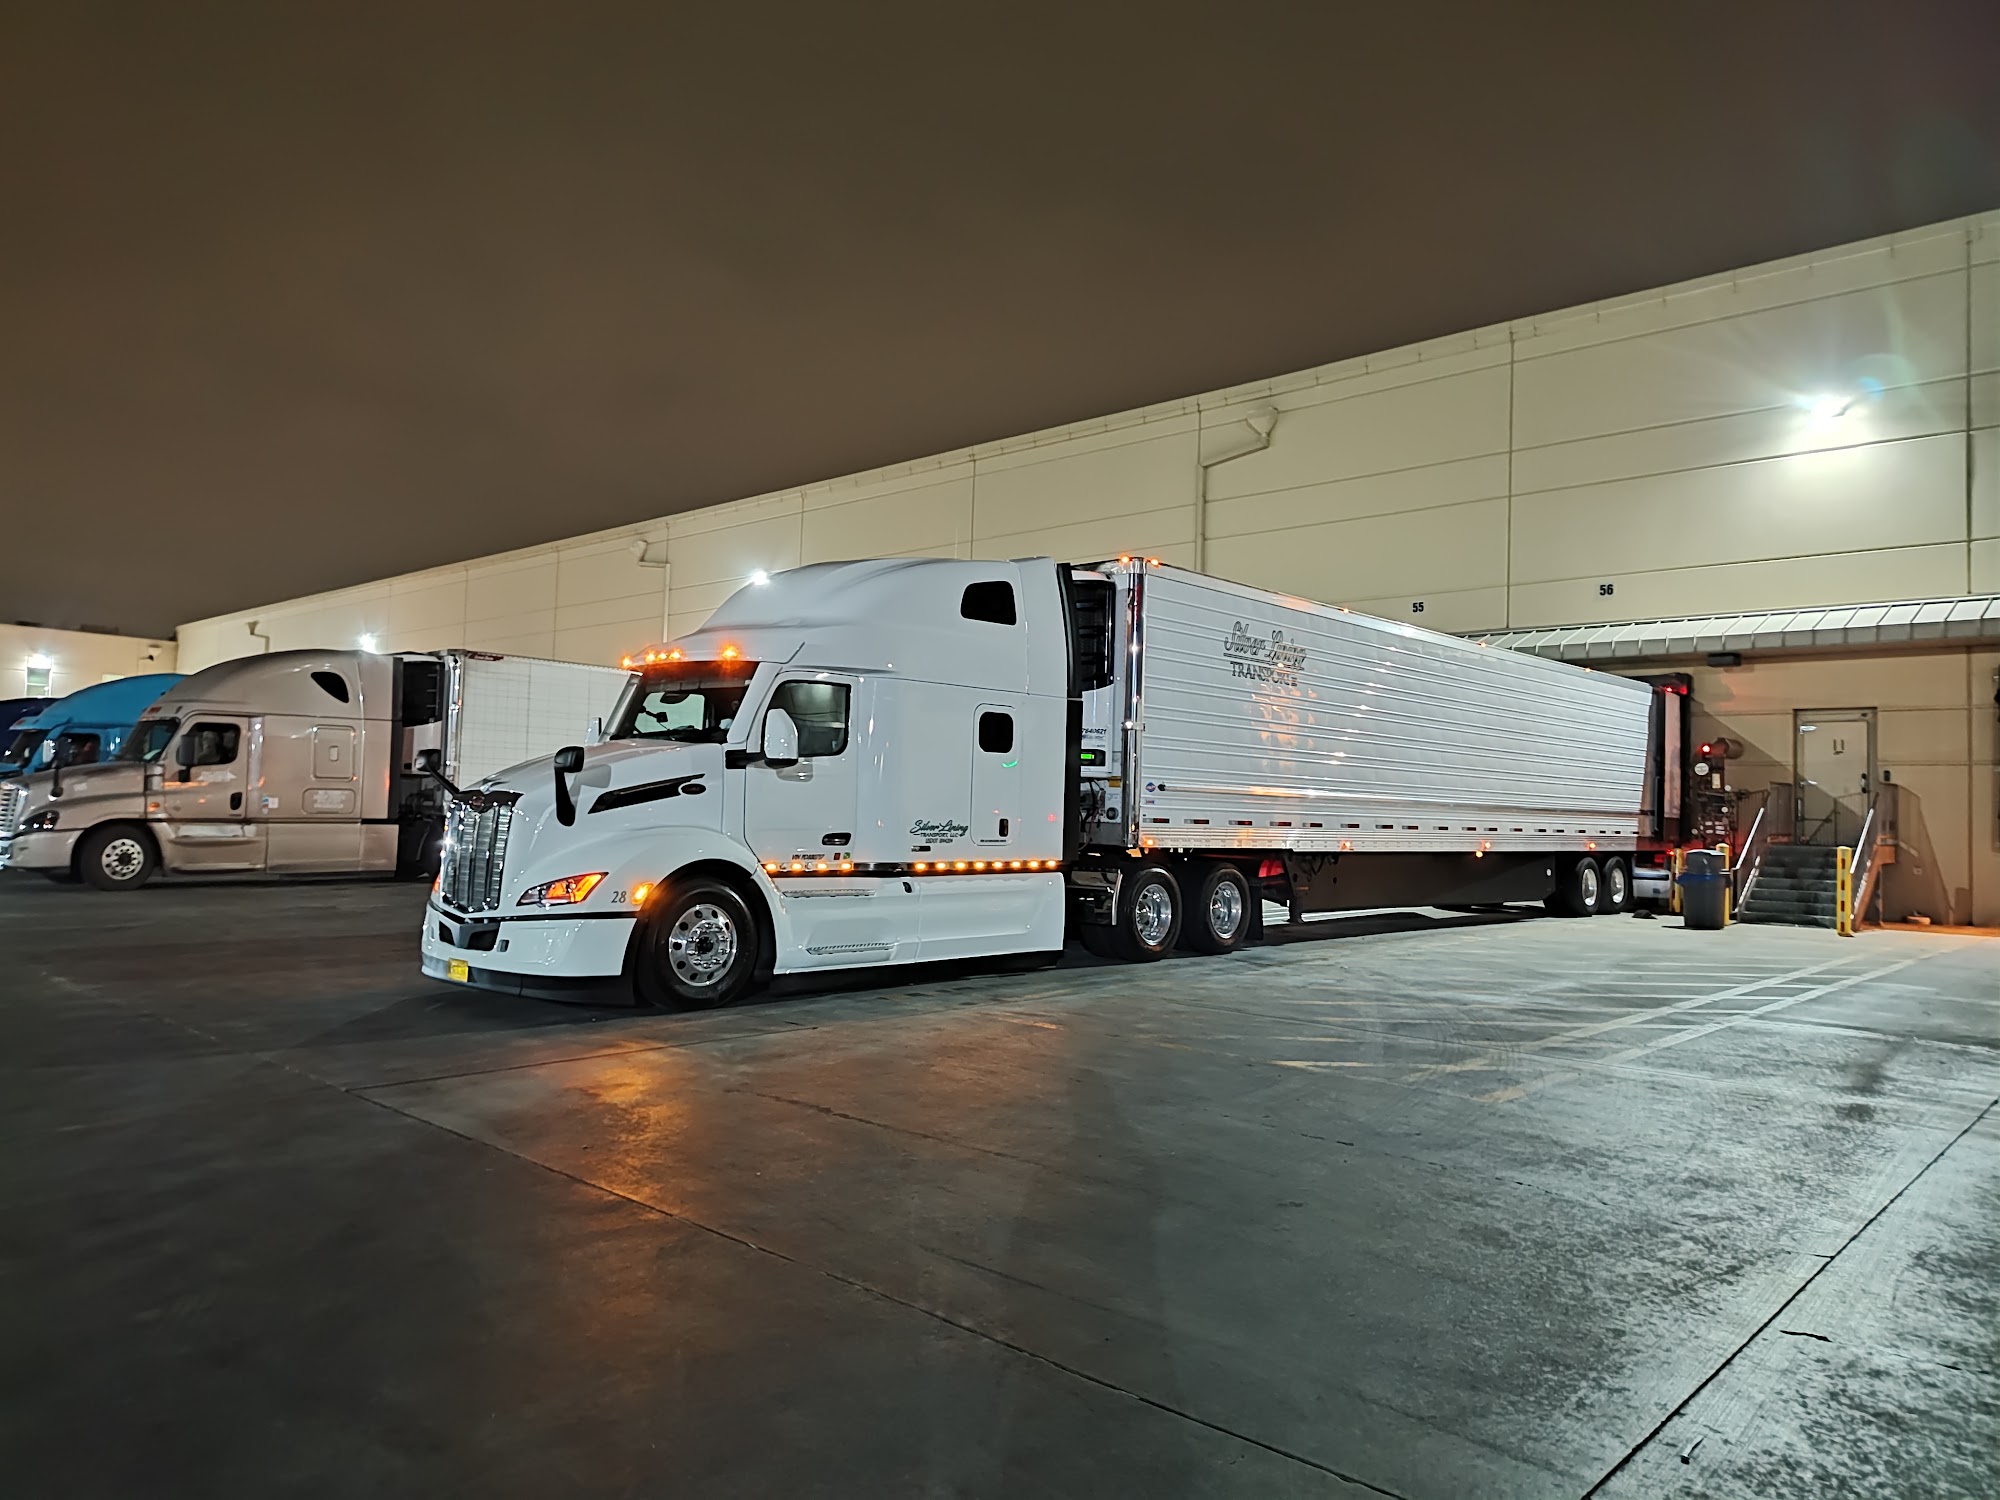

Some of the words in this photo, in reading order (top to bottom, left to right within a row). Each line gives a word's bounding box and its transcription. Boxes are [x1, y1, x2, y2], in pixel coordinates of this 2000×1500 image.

[1600, 584, 1614, 595] 56
[1412, 602, 1424, 612] 55
[910, 819, 940, 833] Silver
[938, 819, 968, 837] Lining
[610, 890, 627, 903] 28
